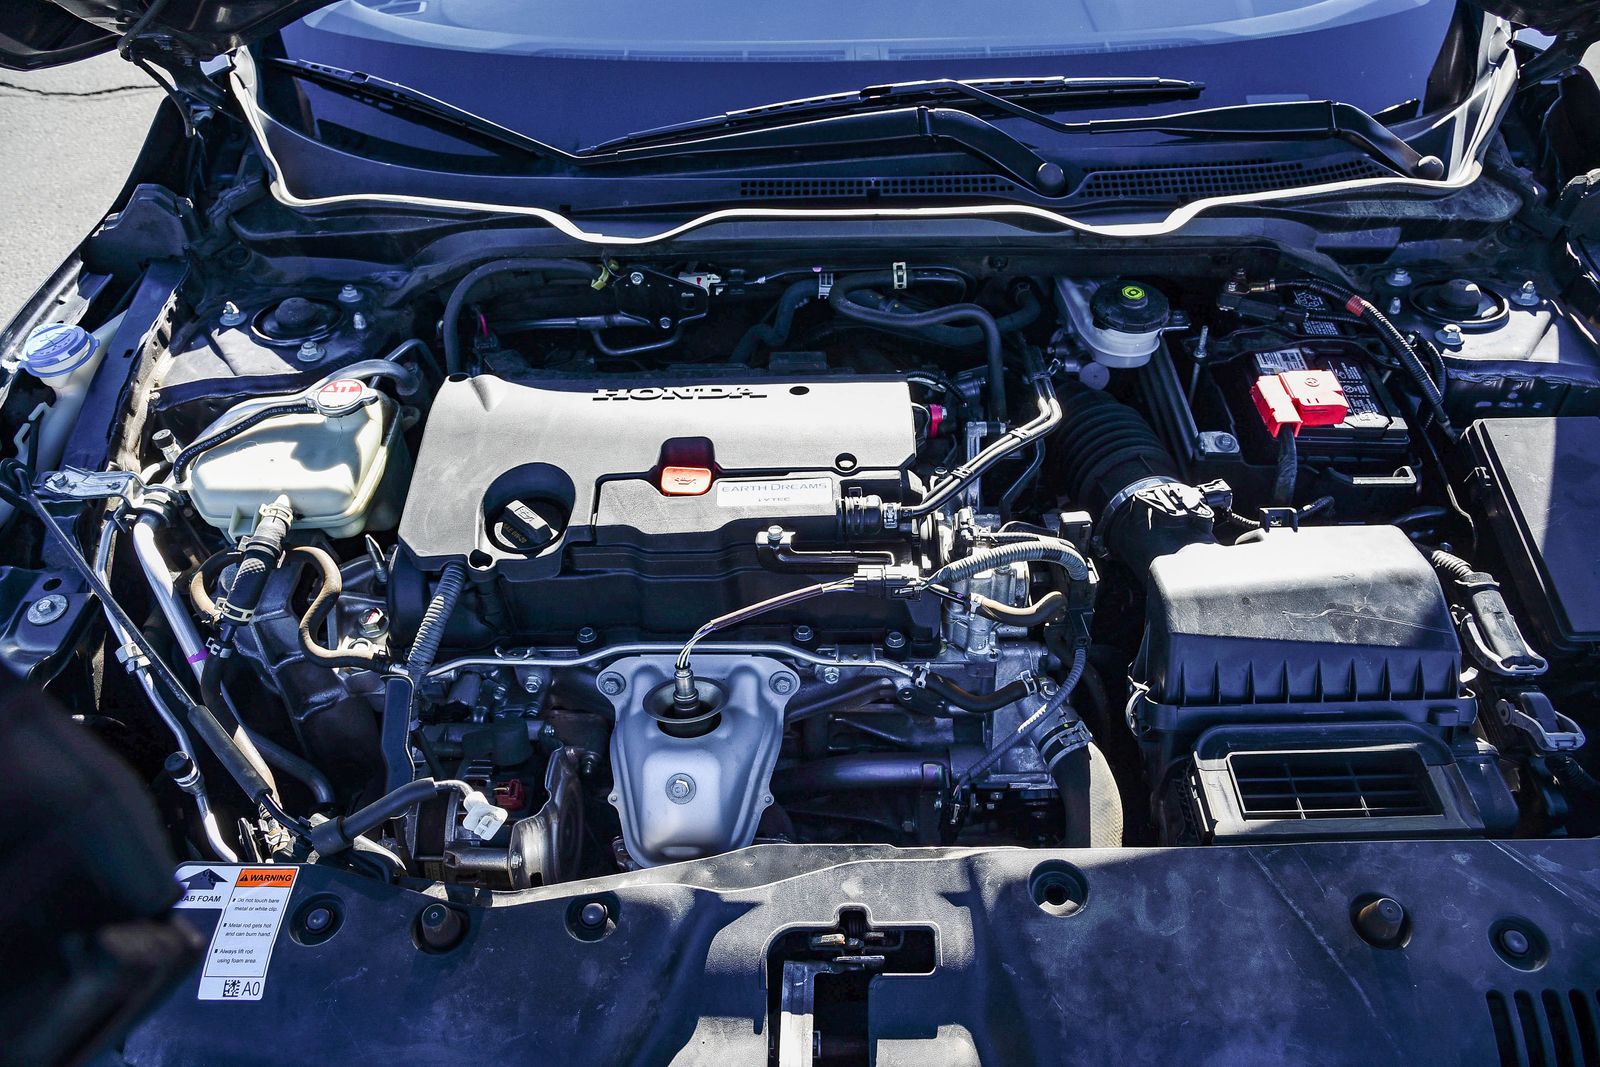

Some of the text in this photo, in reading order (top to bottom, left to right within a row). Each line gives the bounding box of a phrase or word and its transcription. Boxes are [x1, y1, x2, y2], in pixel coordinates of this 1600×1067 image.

[592, 386, 767, 401] HONDA
[721, 484, 767, 492] EARTH
[250, 874, 292, 882] WARNING
